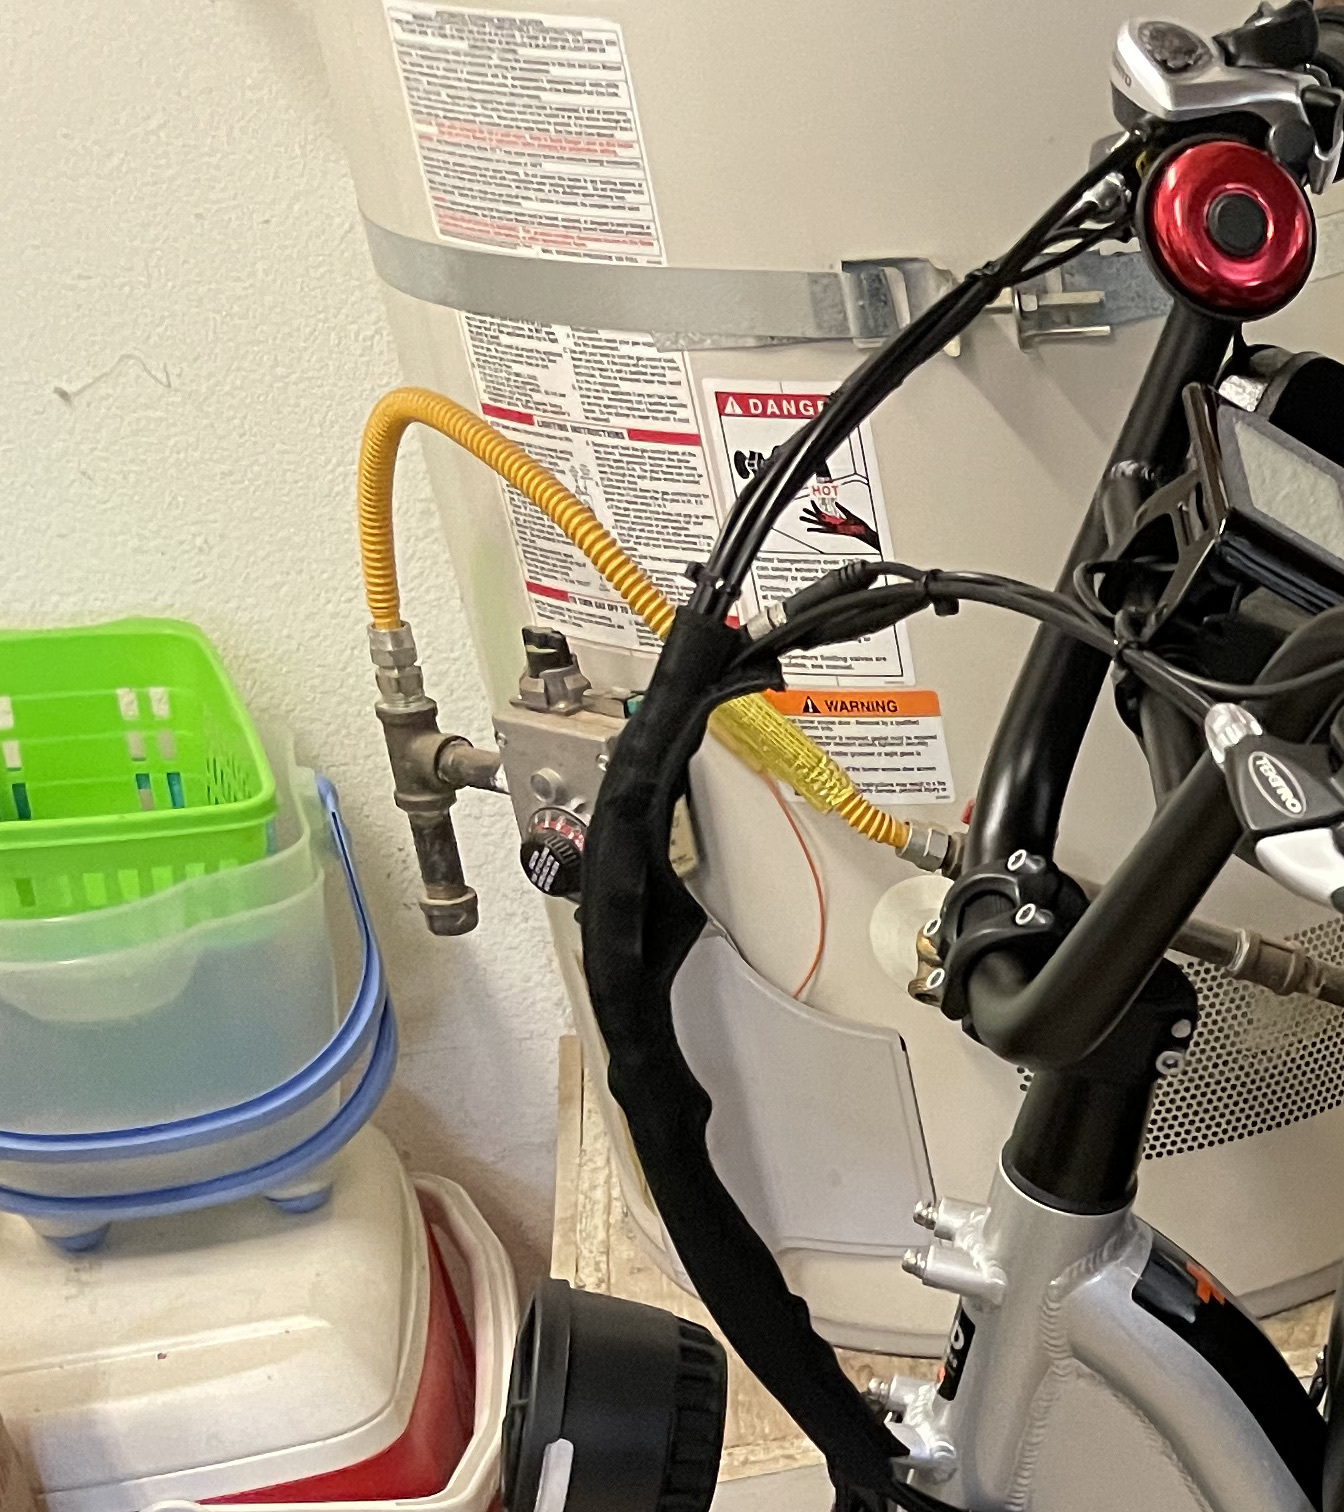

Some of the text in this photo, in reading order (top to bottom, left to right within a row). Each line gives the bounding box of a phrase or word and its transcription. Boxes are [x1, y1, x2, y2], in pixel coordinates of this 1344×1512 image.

[749, 399, 826, 416] DANG
[812, 485, 838, 496] HOT
[825, 700, 898, 713] WARNING
